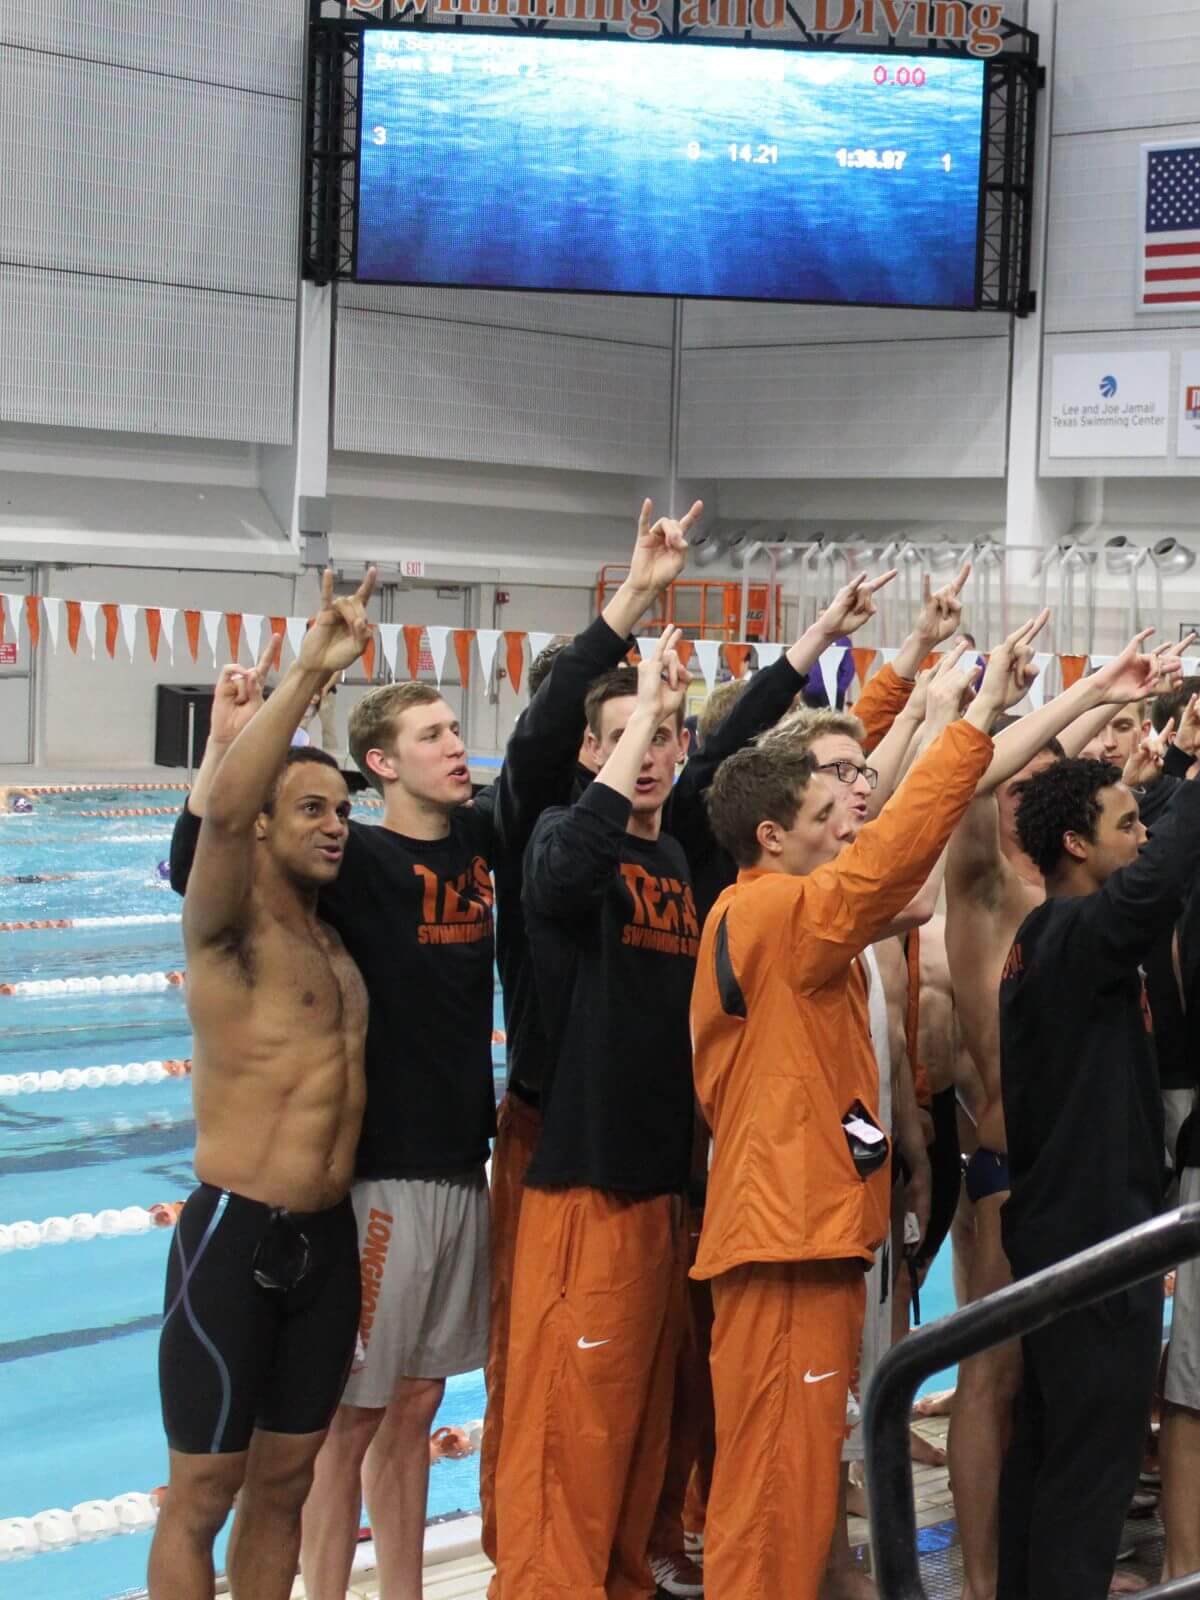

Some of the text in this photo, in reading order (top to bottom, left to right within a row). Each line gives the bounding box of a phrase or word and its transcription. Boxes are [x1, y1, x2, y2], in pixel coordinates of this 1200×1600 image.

[809, 0, 1003, 56] Diving
[873, 65, 926, 87] 0.00
[373, 126, 387, 145] 3
[728, 143, 778, 164] 14.21
[941, 153, 951, 172] 1
[1062, 402, 1155, 415] Lee and Joe Jamail
[1053, 415, 1165, 428] Texas Swimming Center
[406, 561, 422, 576] EXIT
[620, 863, 700, 938] TEXA
